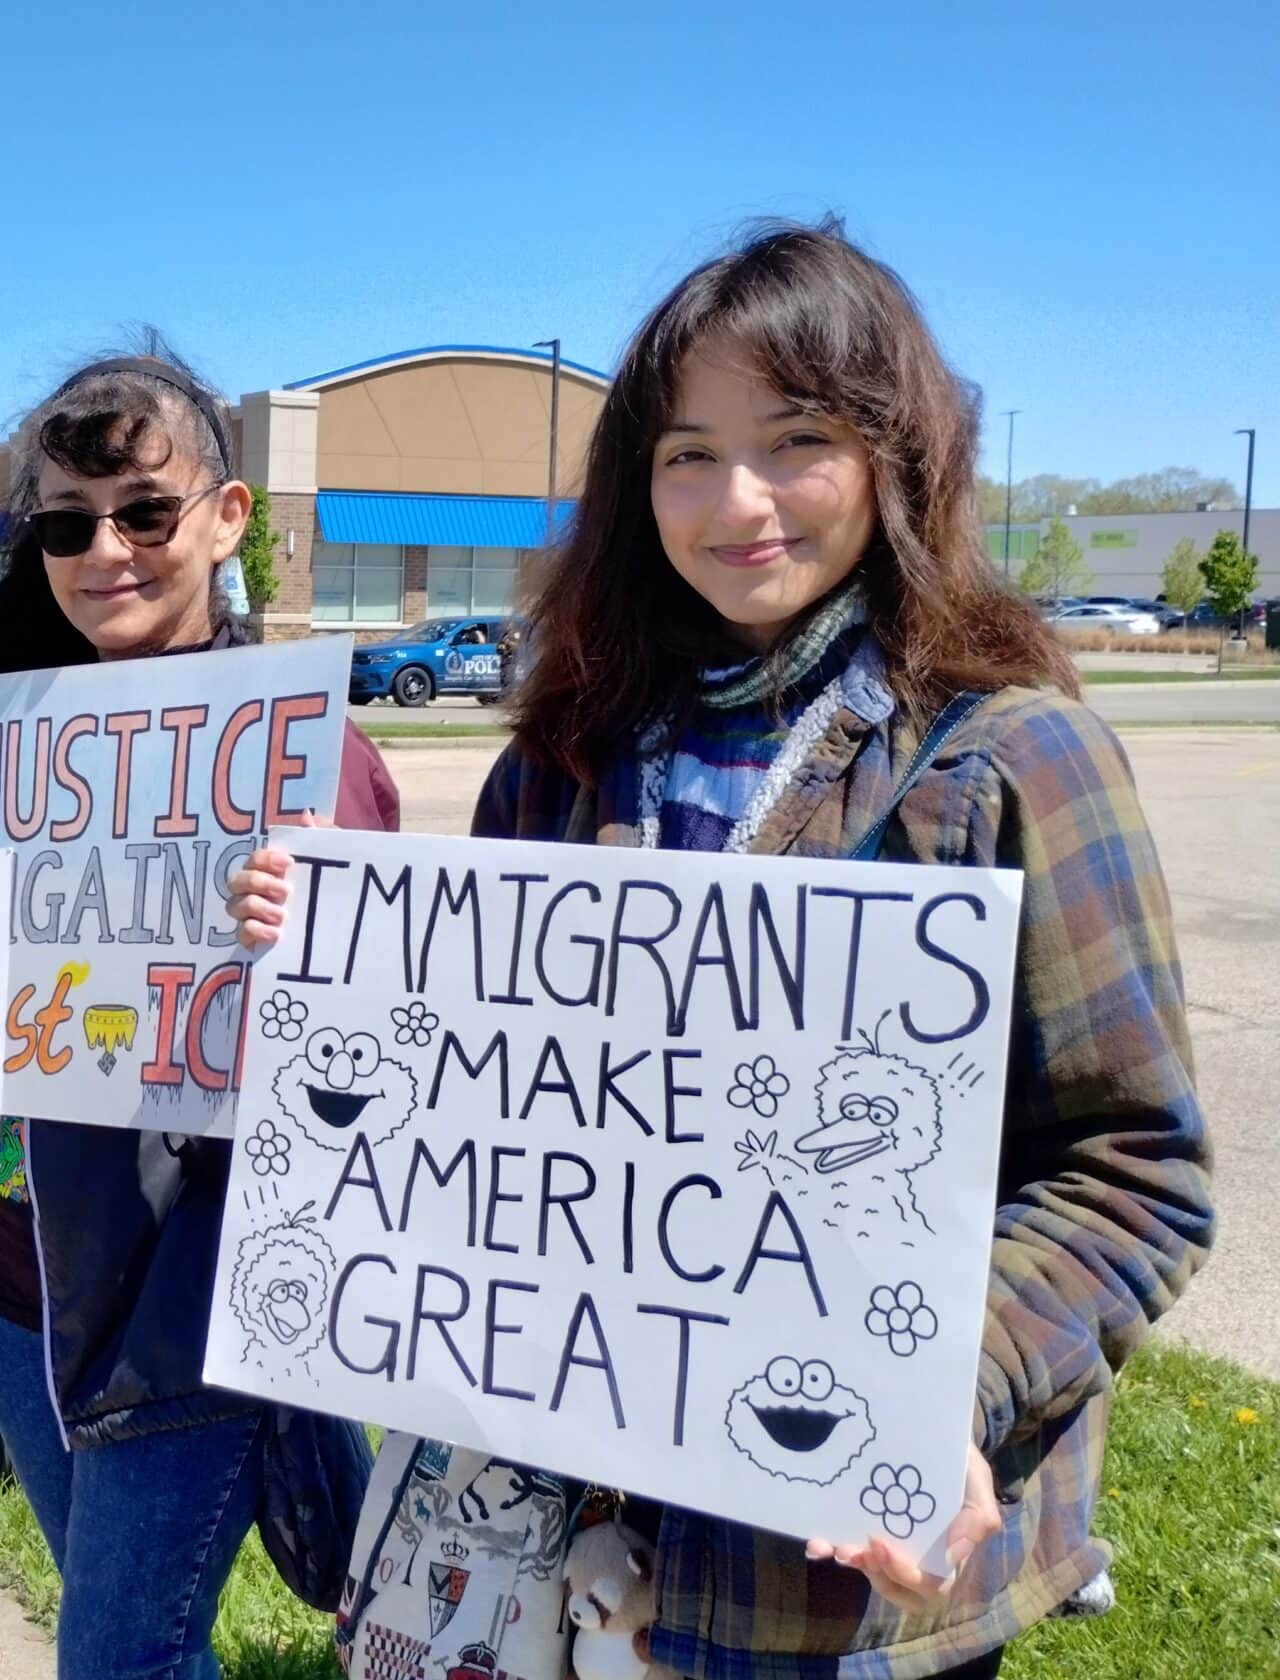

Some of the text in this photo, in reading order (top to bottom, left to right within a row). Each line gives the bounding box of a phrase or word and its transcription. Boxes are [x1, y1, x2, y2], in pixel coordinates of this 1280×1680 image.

[464, 660, 501, 674] POL
[9, 837, 269, 946] GAINS
[276, 855, 991, 1044] IMMIGRANTS
[141, 961, 253, 1092] IC
[427, 1030, 704, 1144] MAKE
[324, 1131, 829, 1317] AMERICA
[329, 1253, 730, 1446] GREAT
